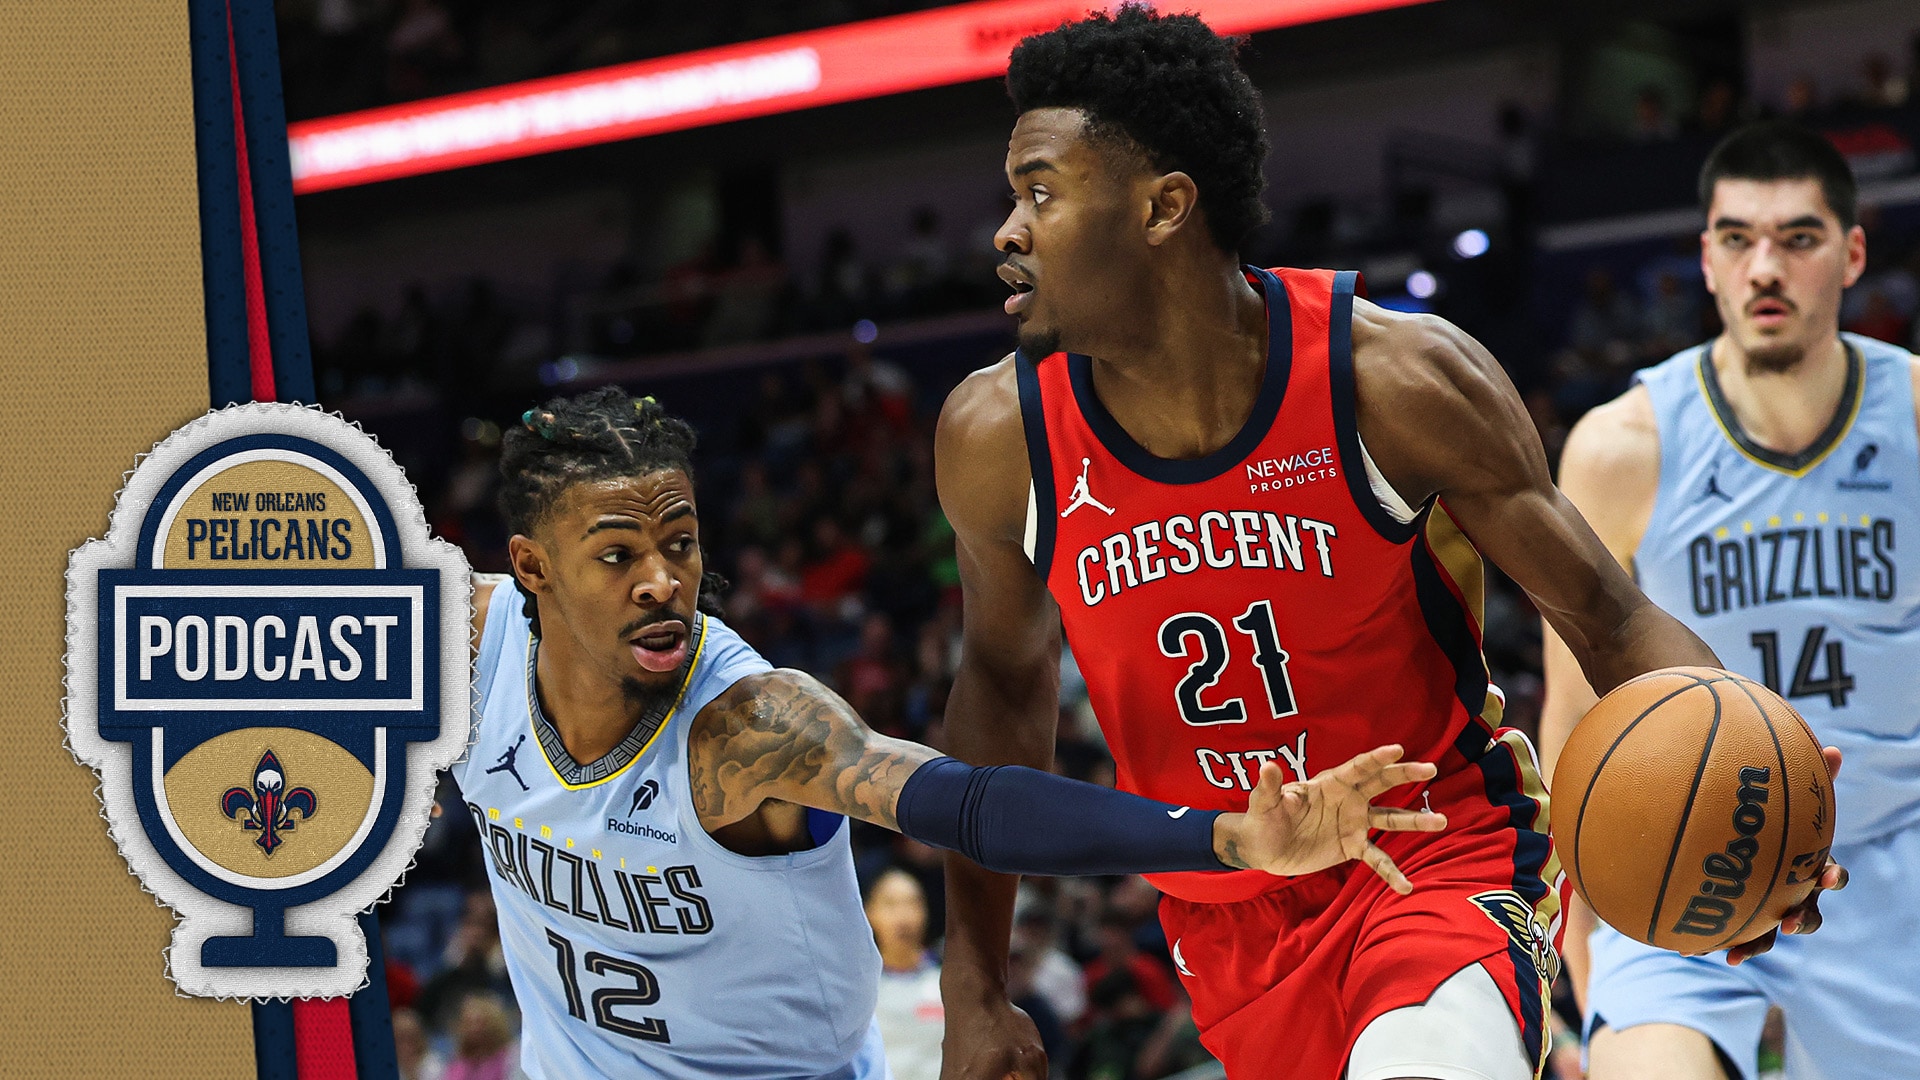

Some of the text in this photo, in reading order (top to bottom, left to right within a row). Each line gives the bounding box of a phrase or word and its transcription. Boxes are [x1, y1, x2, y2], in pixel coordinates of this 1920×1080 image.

[1246, 447, 1334, 481] NEWAGE
[1250, 467, 1338, 494] PRODUCTS
[1076, 510, 1337, 607] CRESCENT
[1688, 518, 1896, 618] GRIZZLIES
[1157, 599, 1299, 727] 21
[1751, 626, 1855, 708] 14
[607, 818, 678, 845] Robinhood
[1671, 766, 1770, 937] Wilson
[545, 926, 671, 1045] 12
